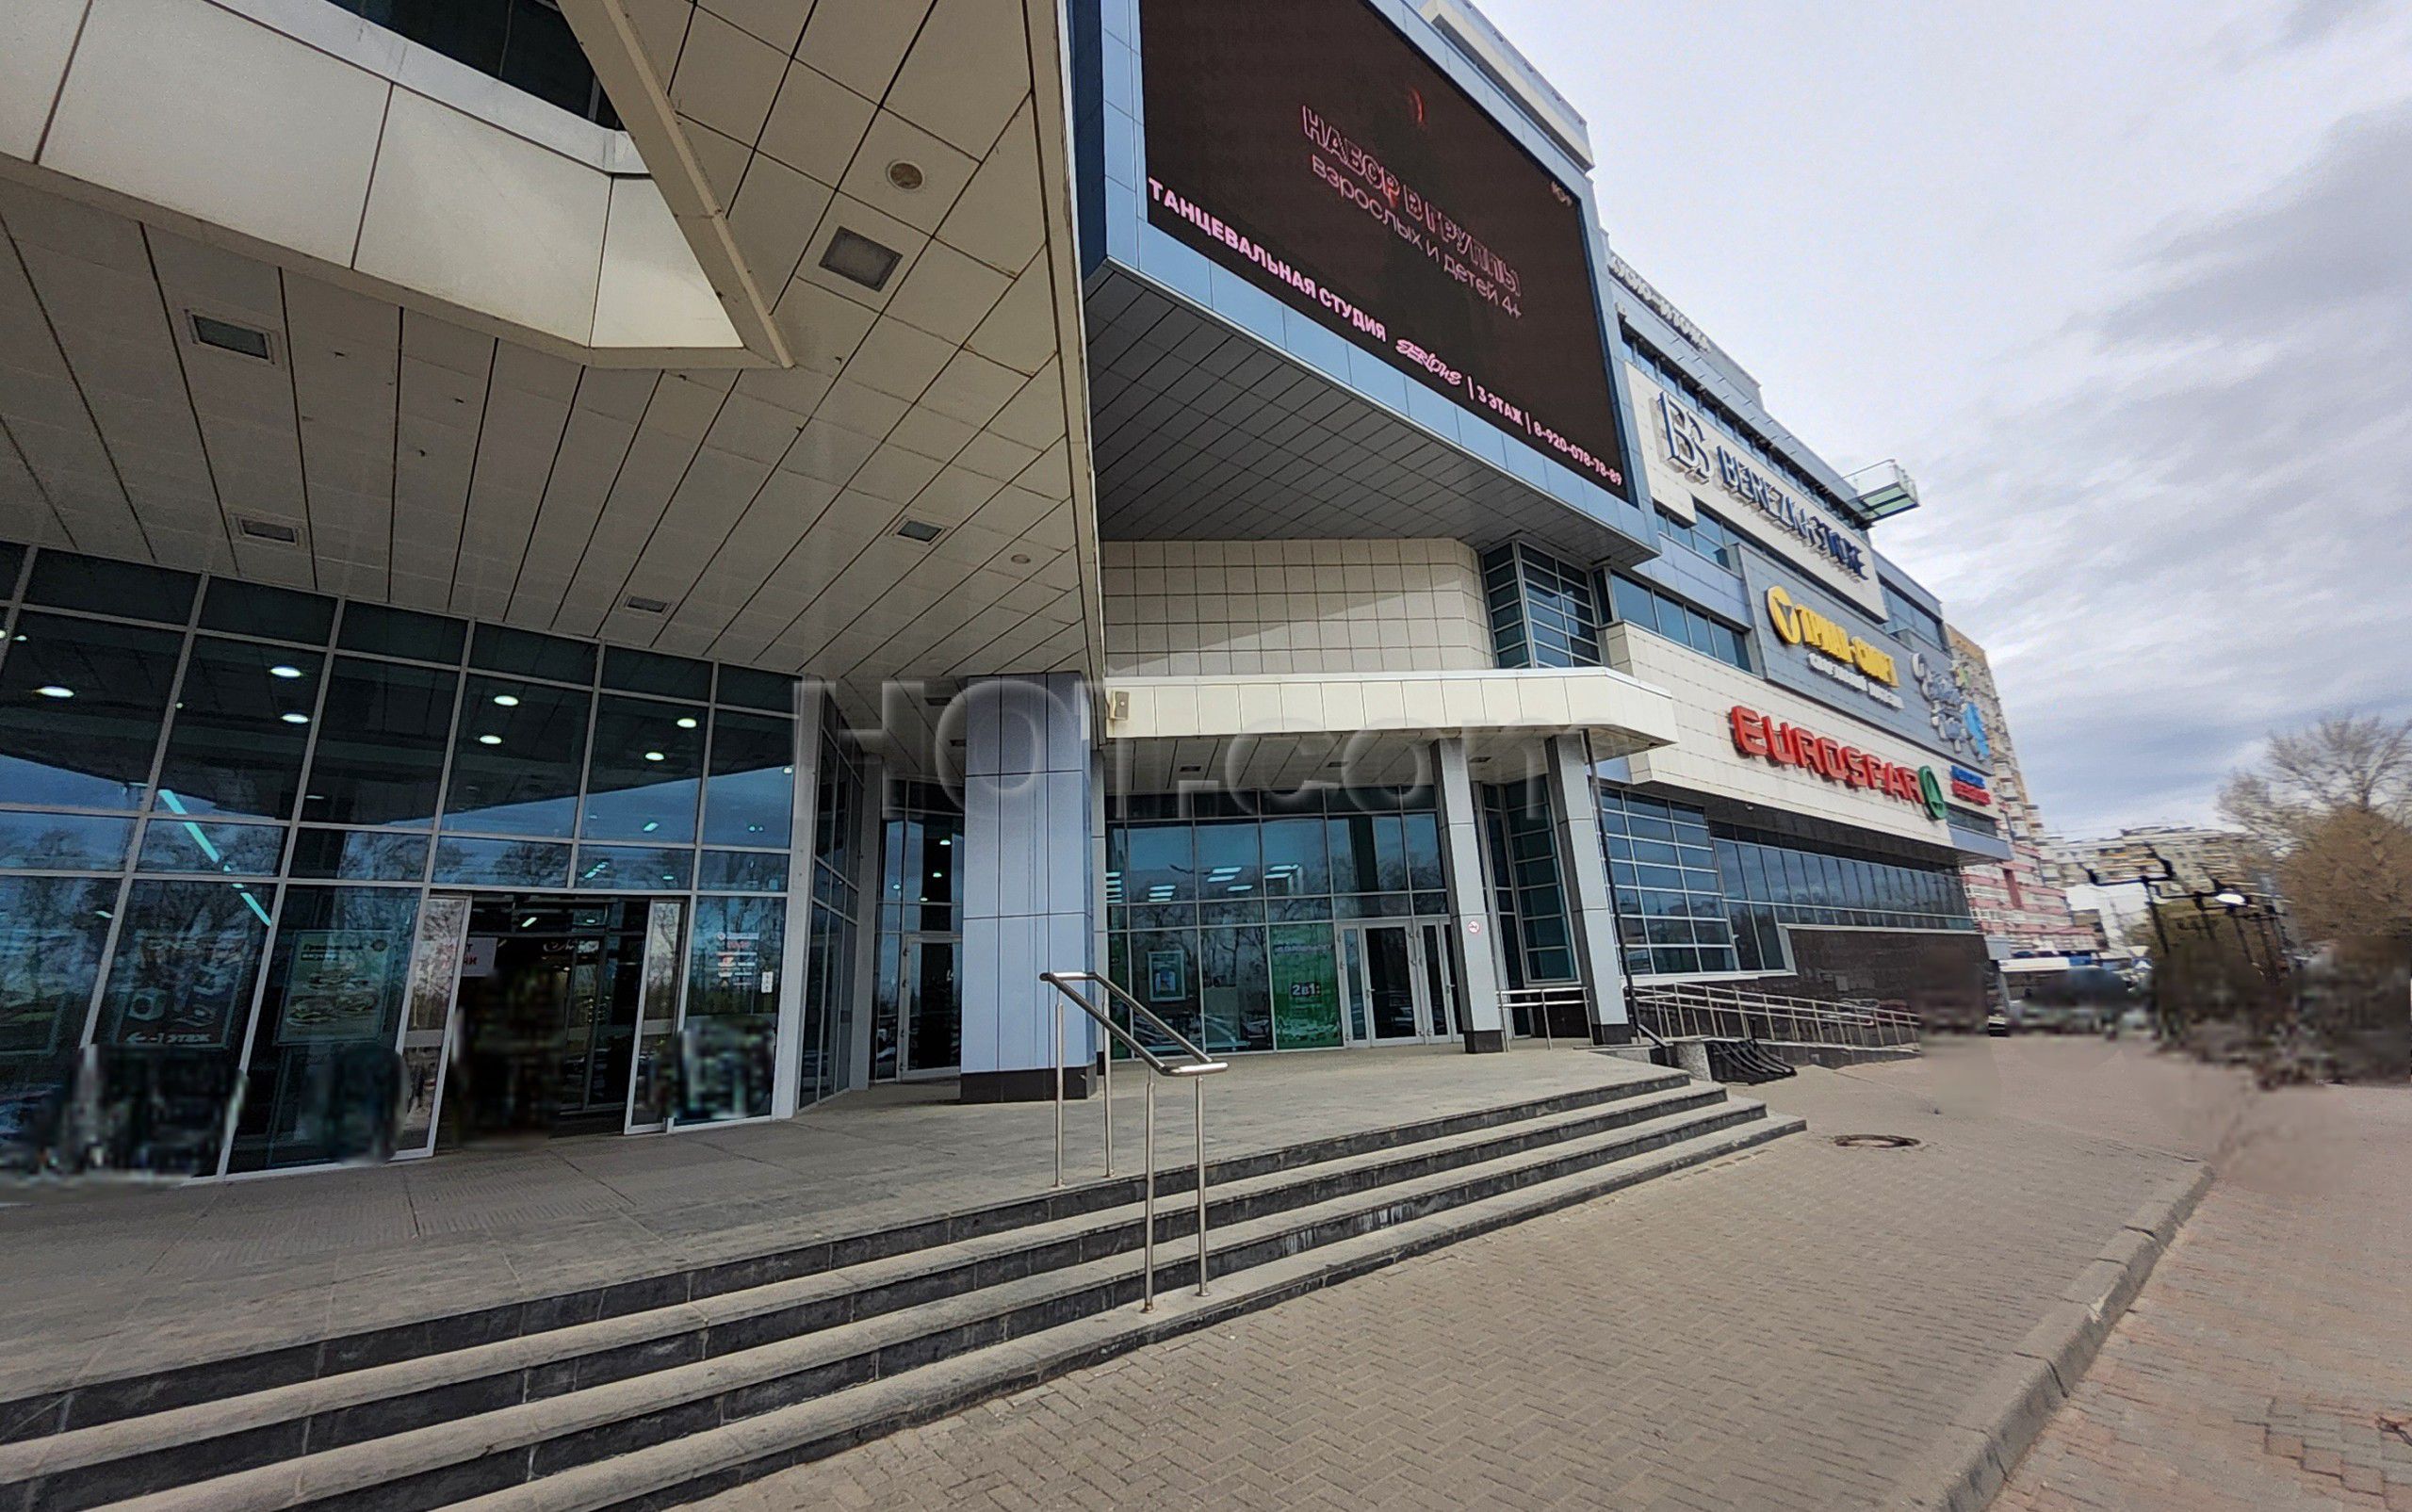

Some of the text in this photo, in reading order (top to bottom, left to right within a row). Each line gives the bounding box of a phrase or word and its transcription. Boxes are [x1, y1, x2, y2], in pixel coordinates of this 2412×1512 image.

[1302, 105, 1401, 199] НАБОР
[1148, 176, 1318, 300] ТАНЦЕВАЛЬНАЯ
[1319, 286, 1387, 343] СТУДИЯ
[1487, 392, 1524, 428] ЭТАЖ
[1444, 254, 1499, 306] детей
[1730, 705, 1925, 805] EUROSPAR
